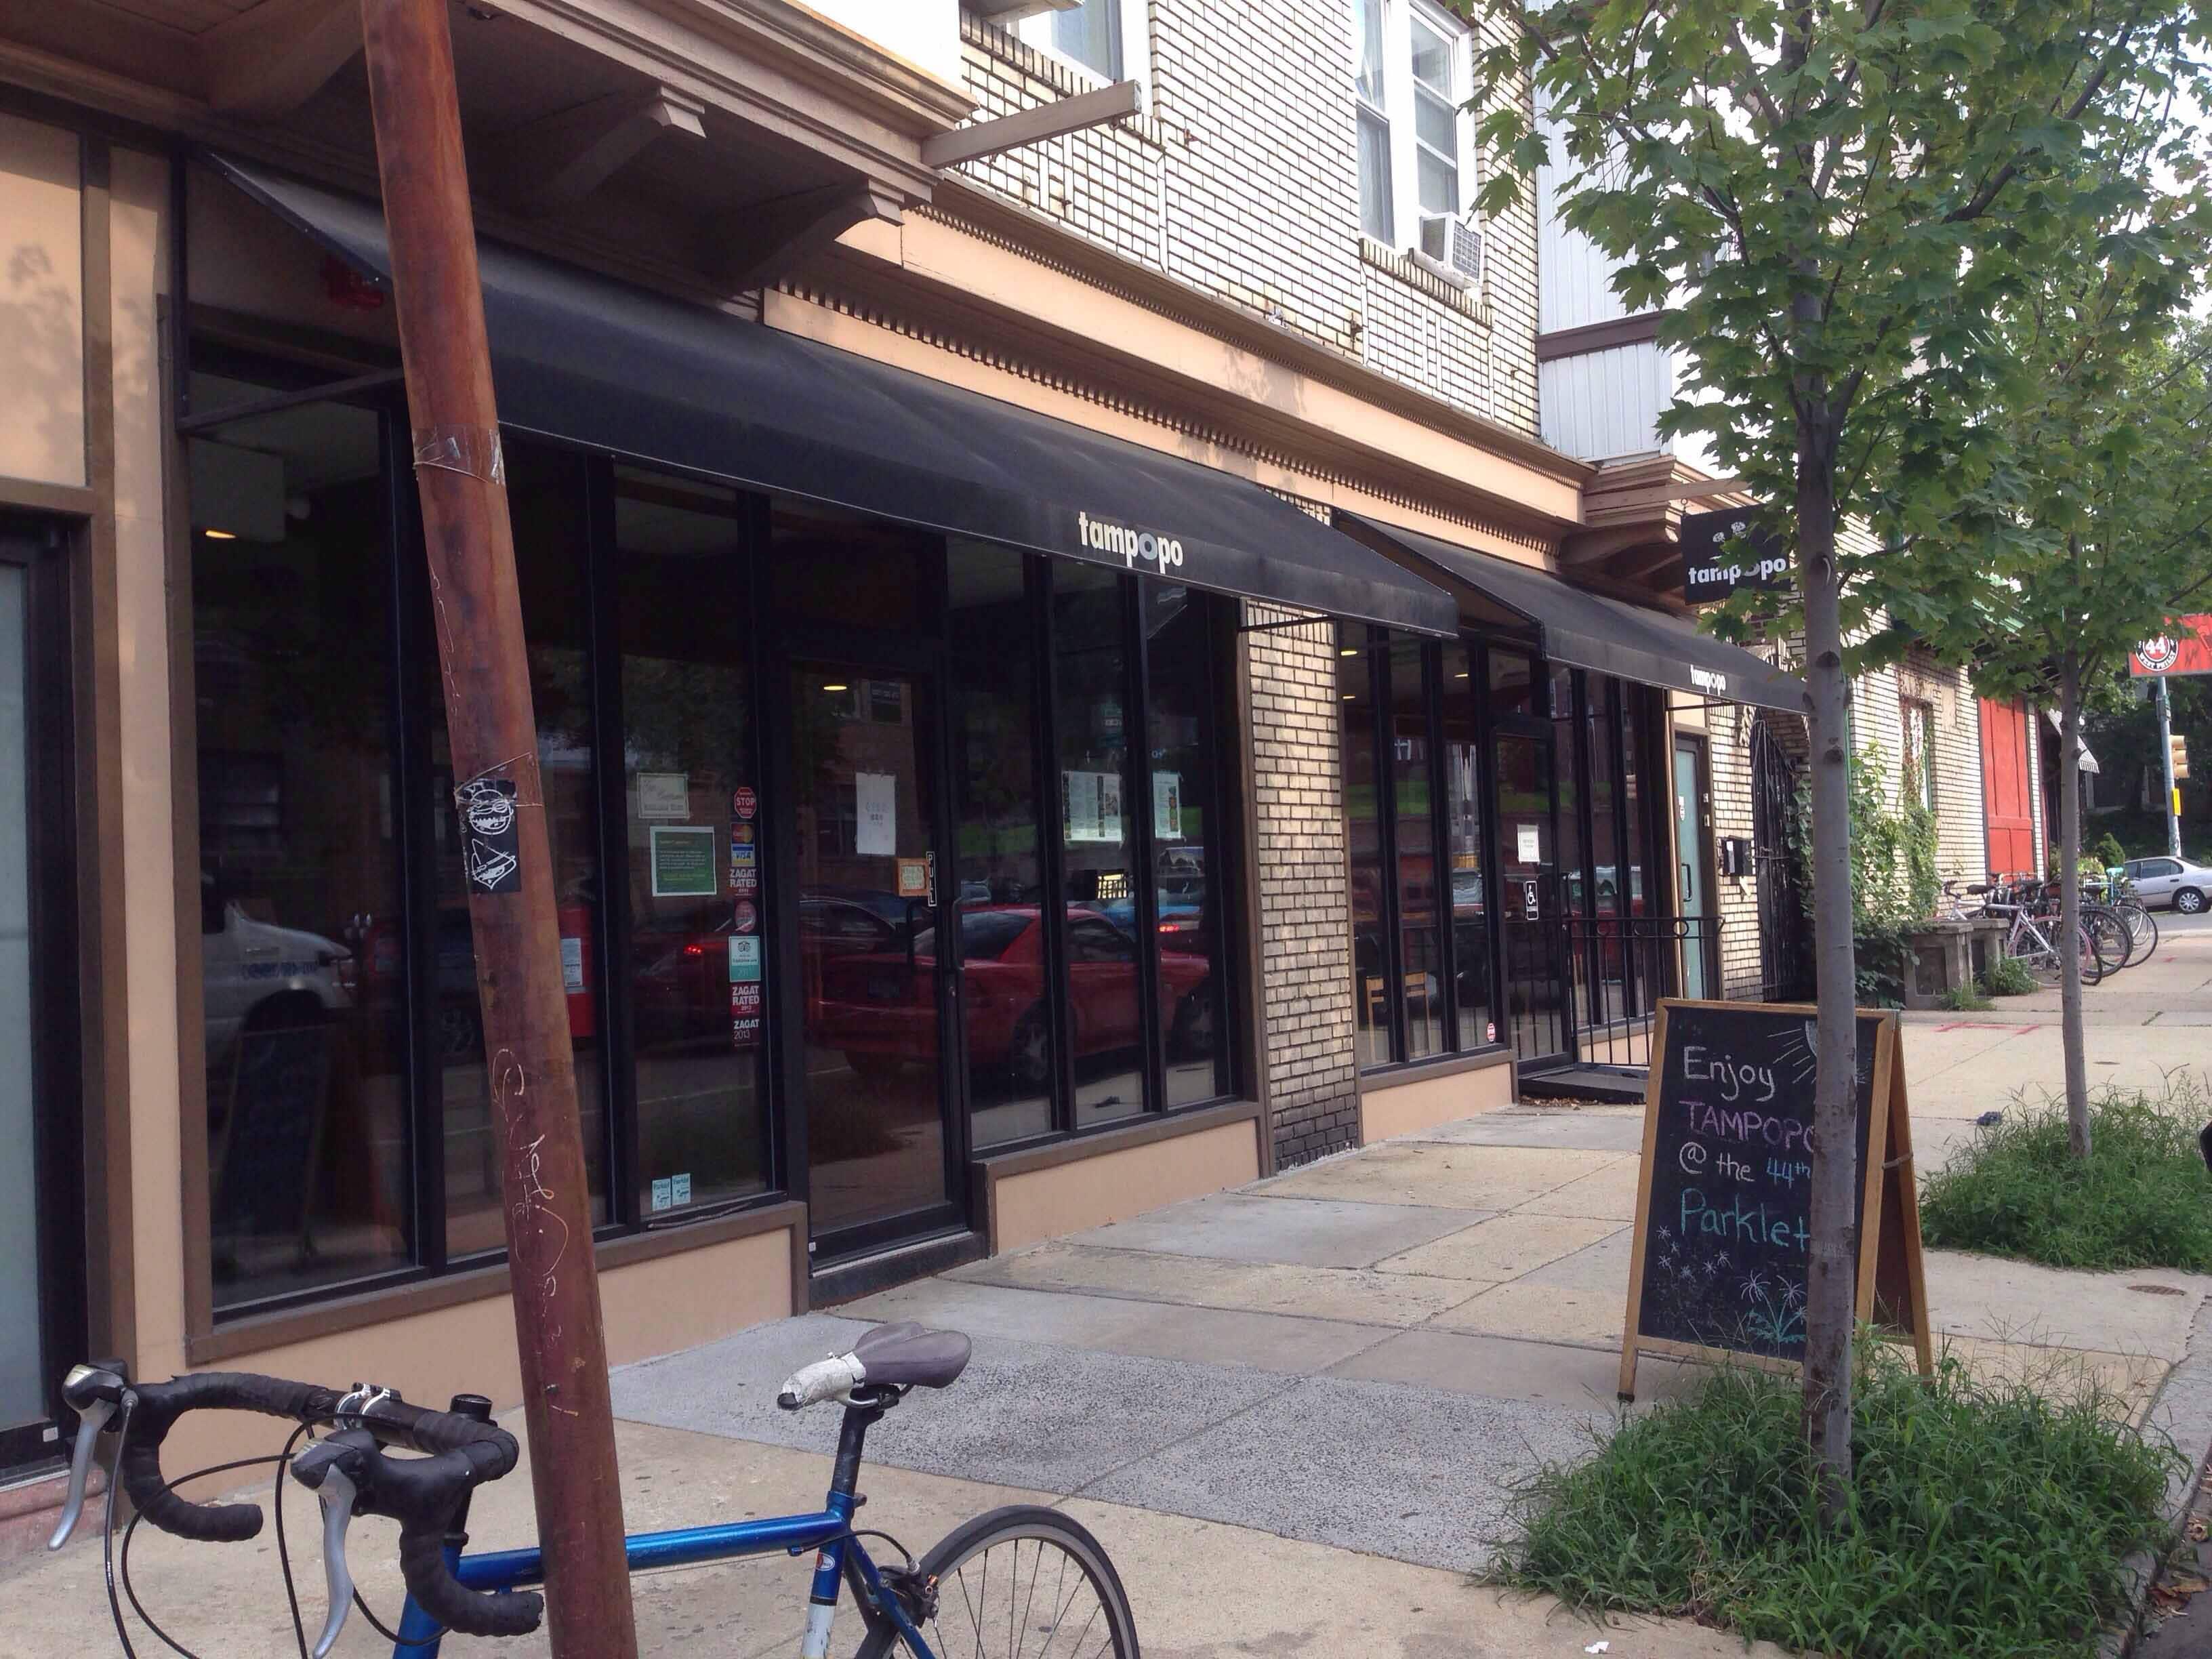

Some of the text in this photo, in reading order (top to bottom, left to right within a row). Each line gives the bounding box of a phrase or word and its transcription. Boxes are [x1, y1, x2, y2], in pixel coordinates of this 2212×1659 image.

[1079, 511, 1183, 574] tampopo
[1690, 664, 1726, 696] tampopo
[736, 797, 754, 806] STOP
[730, 869, 757, 878] ZAGAT
[730, 879, 757, 888] RATED
[733, 985, 759, 996] ZAGAT
[733, 996, 759, 1006] RATED
[734, 1019, 759, 1029] ZAGAT
[733, 1030, 750, 1040] 2013
[1683, 1046, 1776, 1102] Enjoy
[1680, 1142, 1811, 1189] @ the 44th
[1681, 1187, 1811, 1252] Parklet
